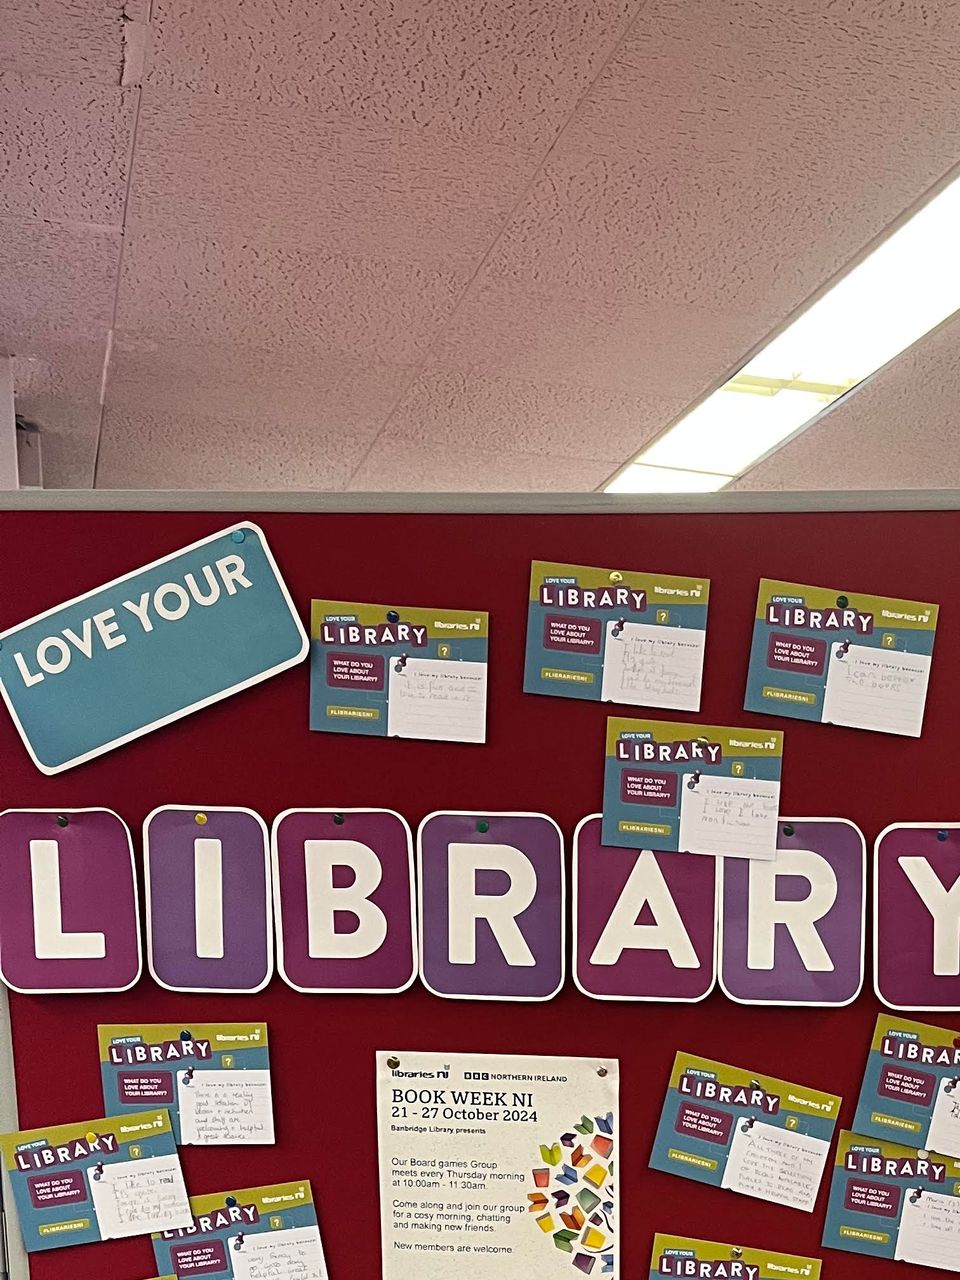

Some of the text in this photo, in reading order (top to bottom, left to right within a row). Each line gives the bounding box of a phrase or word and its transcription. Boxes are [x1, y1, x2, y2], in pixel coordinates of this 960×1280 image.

[542, 588, 645, 610] LIBRARY
[14, 554, 252, 687] LOVE YOUR
[769, 606, 872, 633] LIBRARY
[323, 624, 426, 646] LIBRARY
[619, 742, 720, 763] LIBRARY
[111, 1040, 209, 1063] LIBRARY
[392, 1070, 434, 1079] libraries
[491, 1073, 532, 1081] NORTHERN
[392, 1089, 533, 1107] BOOK WEEK NI
[681, 1077, 778, 1112] LIBRARY
[392, 1107, 537, 1122] 21 27 October 2024
[391, 1125, 427, 1133] Banbridge
[429, 1126, 454, 1134] Library
[18, 1135, 114, 1170] LIBRARY
[411, 1158, 436, 1167] Board
[438, 1161, 468, 1169] games
[471, 1161, 497, 1170] Group
[847, 1155, 944, 1181] LIBRARY
[392, 1169, 525, 1182] meets every Thursday morning
[393, 1200, 417, 1208] Come
[420, 1201, 443, 1210] along
[464, 1203, 480, 1212] join
[500, 1205, 525, 1214] group
[393, 1210, 404, 1218] for
[477, 1214, 511, 1224] chatting
[394, 1221, 408, 1229] and
[411, 1221, 442, 1231] making
[415, 1243, 454, 1251] members
